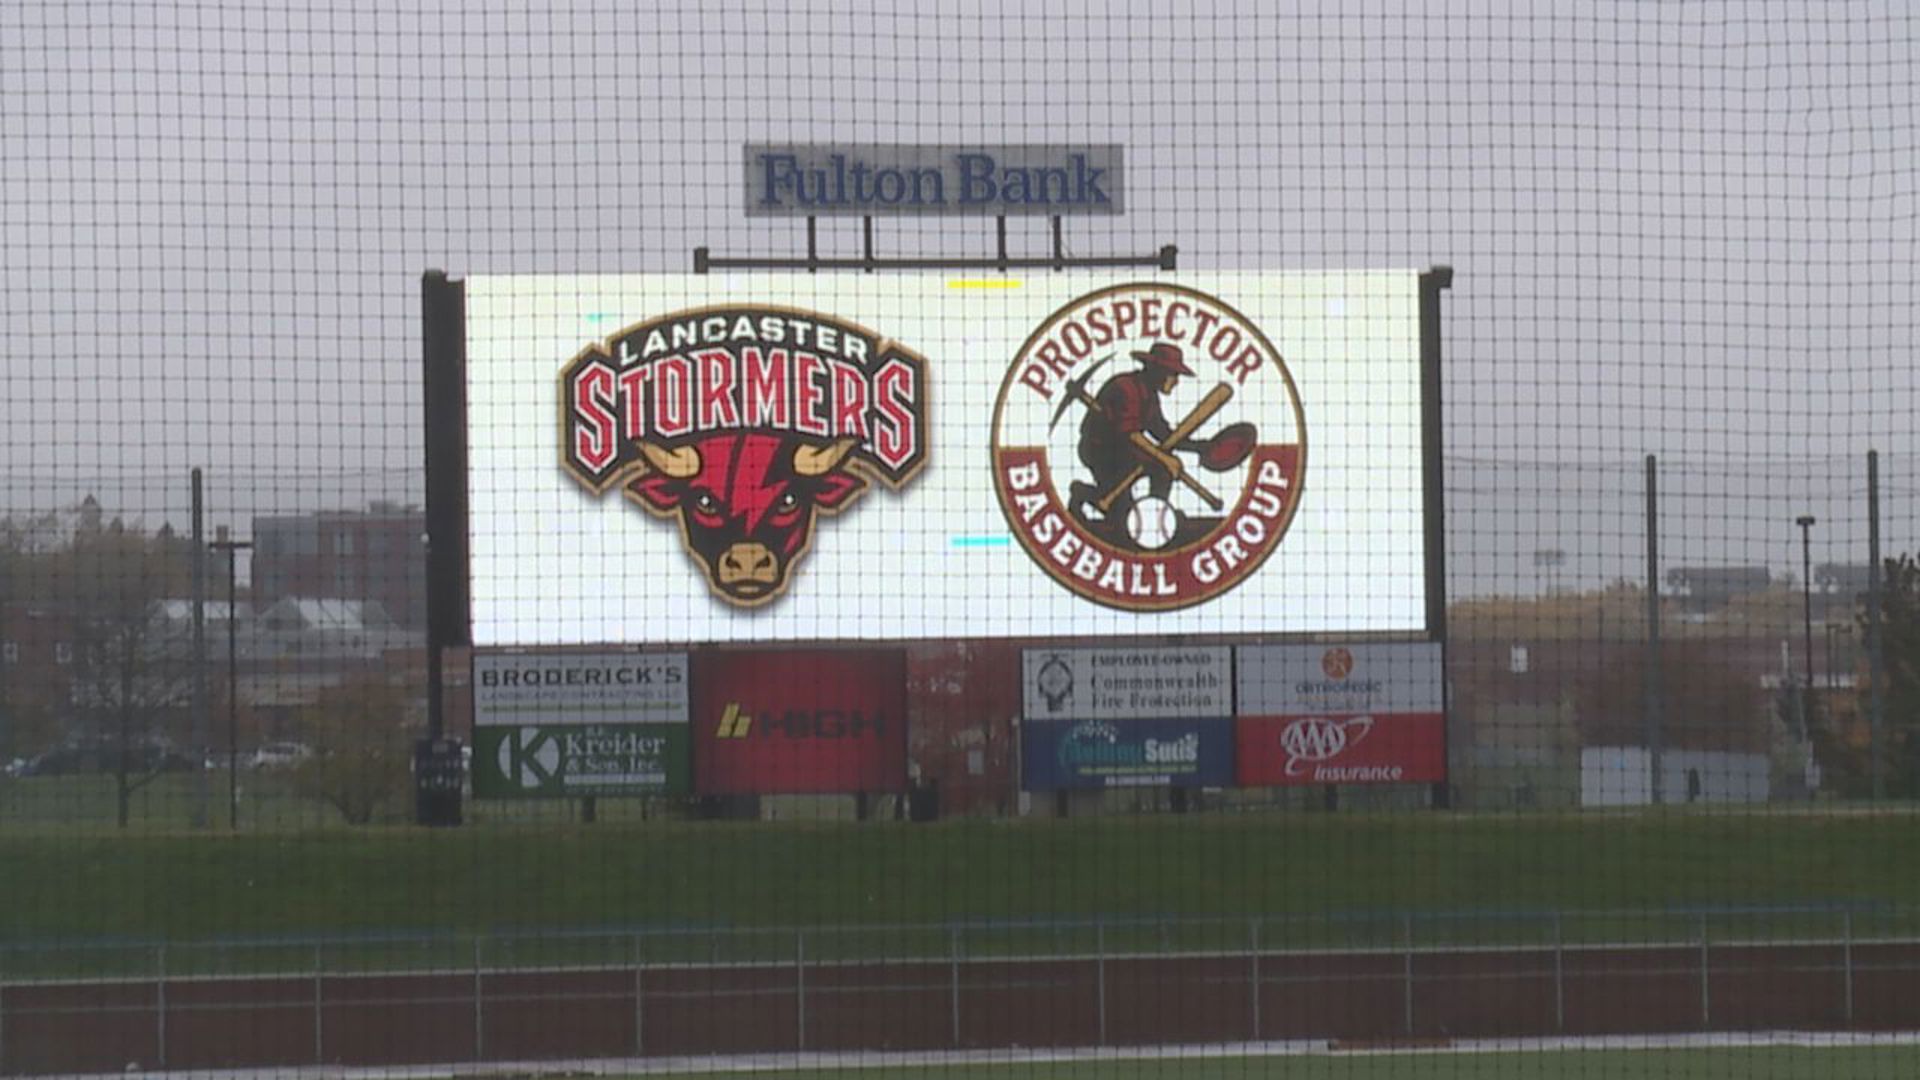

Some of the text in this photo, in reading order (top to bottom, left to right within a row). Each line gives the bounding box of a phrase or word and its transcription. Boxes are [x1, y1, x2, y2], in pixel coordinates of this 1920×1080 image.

[759, 153, 1112, 206] Fulton Bank
[618, 315, 868, 365] LANCASTER
[1018, 299, 1263, 400] PROSPECTOR
[574, 346, 915, 474] STORMERS
[1008, 460, 1288, 596] BASEBALL GROUP
[481, 666, 682, 687] BRODERICK'S
[1091, 671, 1218, 690] Commonwealth
[1092, 691, 1212, 709] Fire Protection
[565, 732, 666, 755] Kreider
